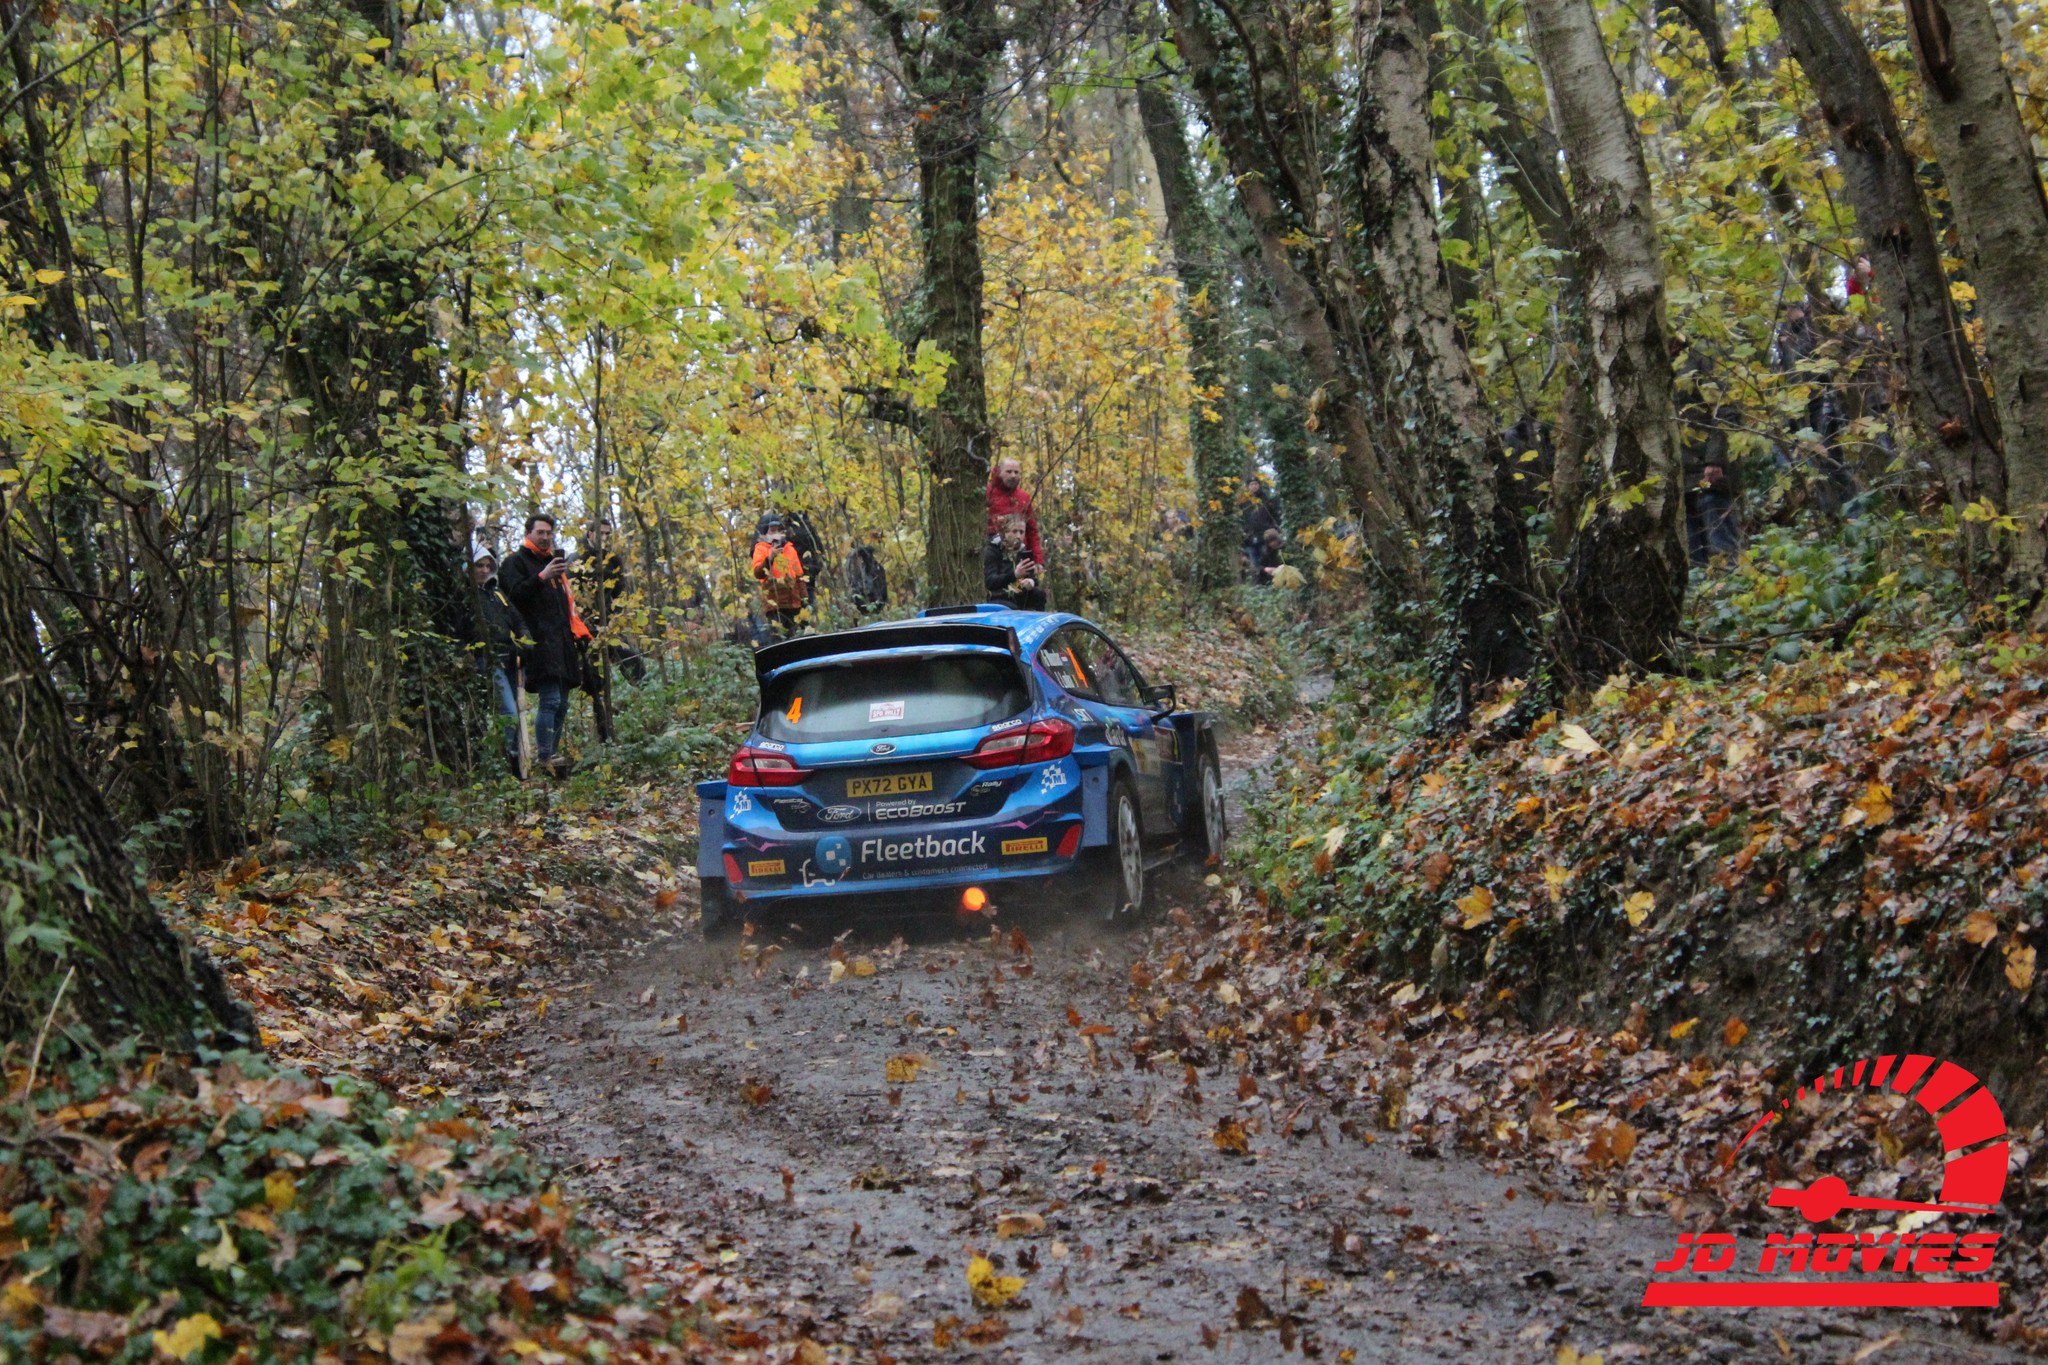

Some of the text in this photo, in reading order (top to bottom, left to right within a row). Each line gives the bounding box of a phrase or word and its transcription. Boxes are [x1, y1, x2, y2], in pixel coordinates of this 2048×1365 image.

[786, 697, 802, 724] 4
[991, 719, 1023, 732] sparco
[758, 741, 785, 751] sparco
[874, 743, 892, 752] Ford
[852, 775, 928, 795] PX72 GYA
[875, 798, 917, 807] Powered by
[875, 801, 967, 820] ECOBOOST
[823, 805, 855, 821] Ford
[861, 830, 986, 863] Fleetback
